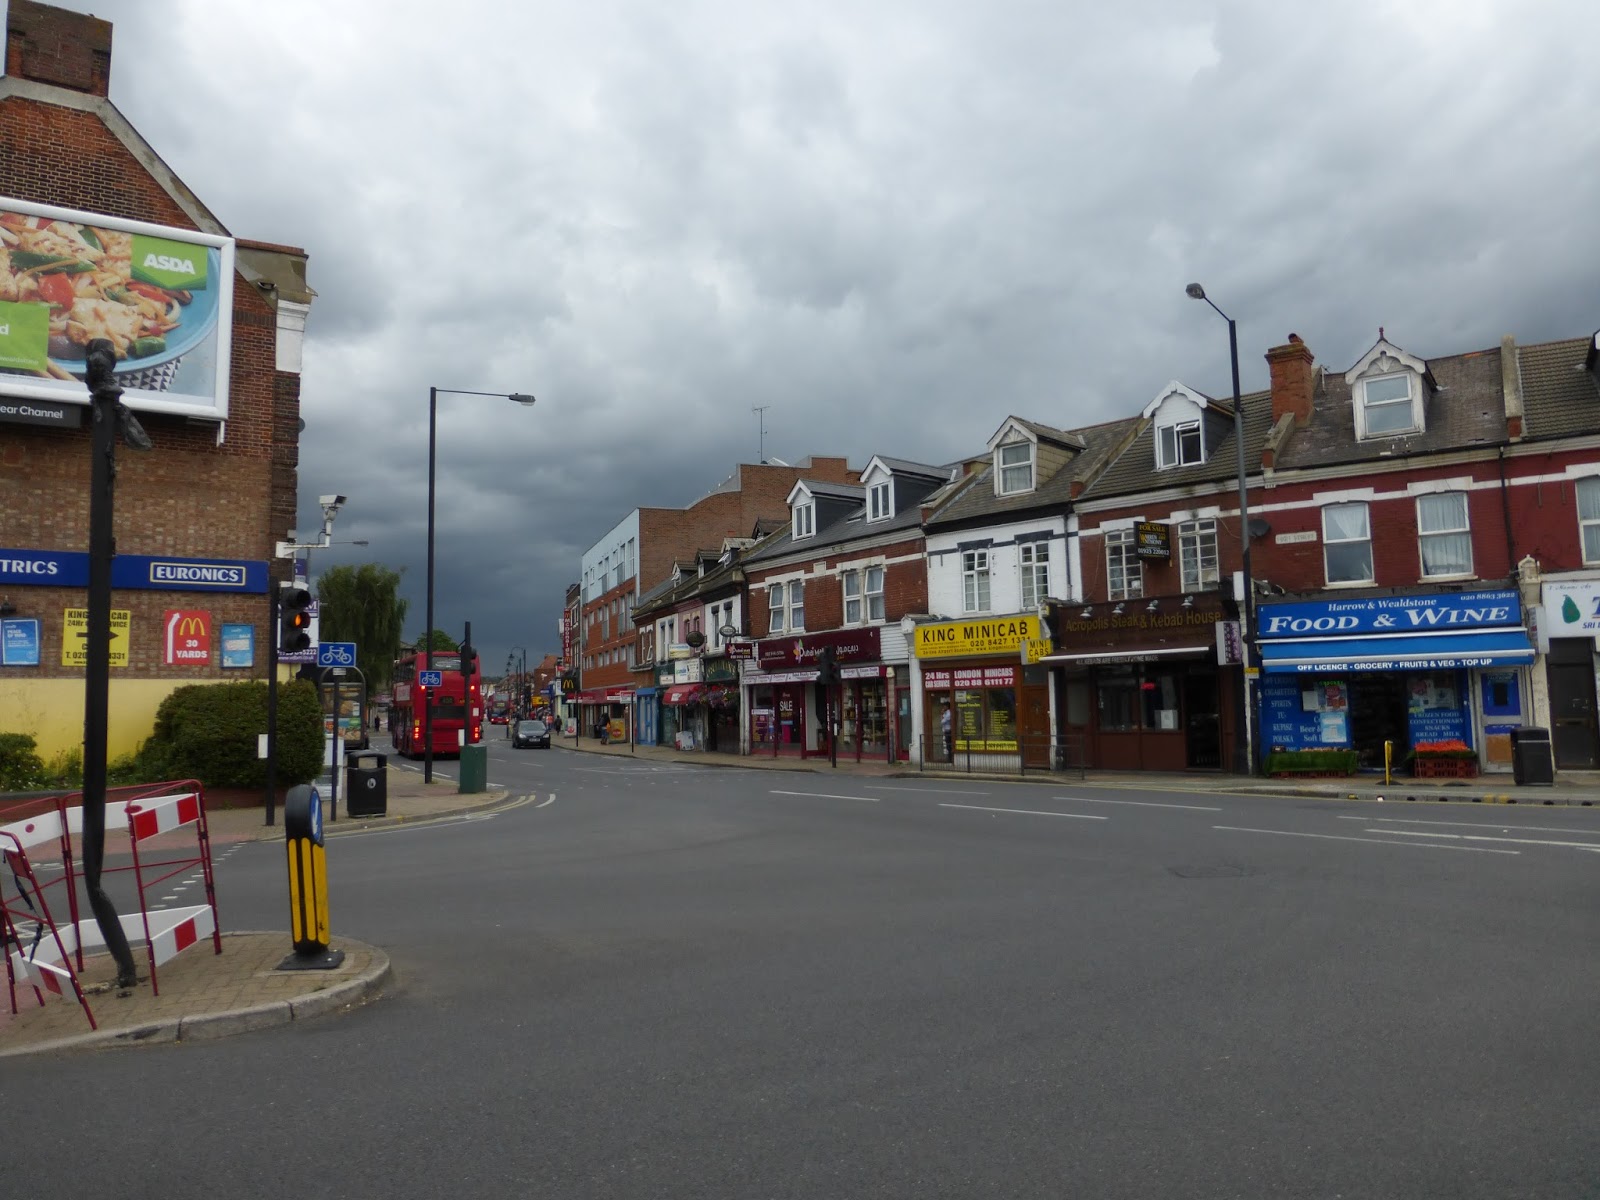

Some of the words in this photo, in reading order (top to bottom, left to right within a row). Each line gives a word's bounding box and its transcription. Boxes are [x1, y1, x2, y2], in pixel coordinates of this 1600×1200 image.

[143, 253, 196, 275] ASDA
[19, 405, 64, 419] Channel
[156, 566, 240, 582] EURONICS
[1328, 602, 1366, 612] Harrow
[1367, 600, 1375, 609] &
[1378, 598, 1437, 609] Wealdstone
[111, 612, 128, 620] CAB
[1265, 615, 1360, 633] FOOD
[1373, 613, 1397, 628] &
[1404, 606, 1510, 626] WINE
[1066, 616, 1109, 634] Acropolis
[1111, 612, 1139, 628] Steak
[1140, 614, 1147, 629] &
[1151, 612, 1183, 628] Kebab
[1186, 610, 1222, 624] House
[923, 628, 955, 643] KING
[963, 621, 1028, 640] MINICAB
[185, 639, 198, 648] 30
[969, 640, 985, 648] 020
[987, 637, 1007, 646] 8427
[1029, 640, 1047, 649] MINI
[176, 650, 208, 658] YARDS
[1029, 648, 1049, 657] CABS
[1314, 663, 1348, 671] LICENCE
[1354, 661, 1393, 670] GROCERY
[1399, 660, 1429, 669] FRUITS
[1429, 660, 1437, 668] &
[1437, 659, 1456, 667] VEG
[1461, 658, 1479, 667] TOP
[1480, 658, 1493, 666] UP
[925, 672, 935, 680] 24
[936, 671, 950, 679] Hrs
[954, 669, 982, 679] LONDON
[984, 667, 1014, 678] MINICABS
[954, 679, 970, 687] 020
[984, 678, 1003, 686] 6111
[779, 700, 793, 712] SALE
[1300, 725, 1316, 733] Beer
[1303, 734, 1317, 742] Soft
